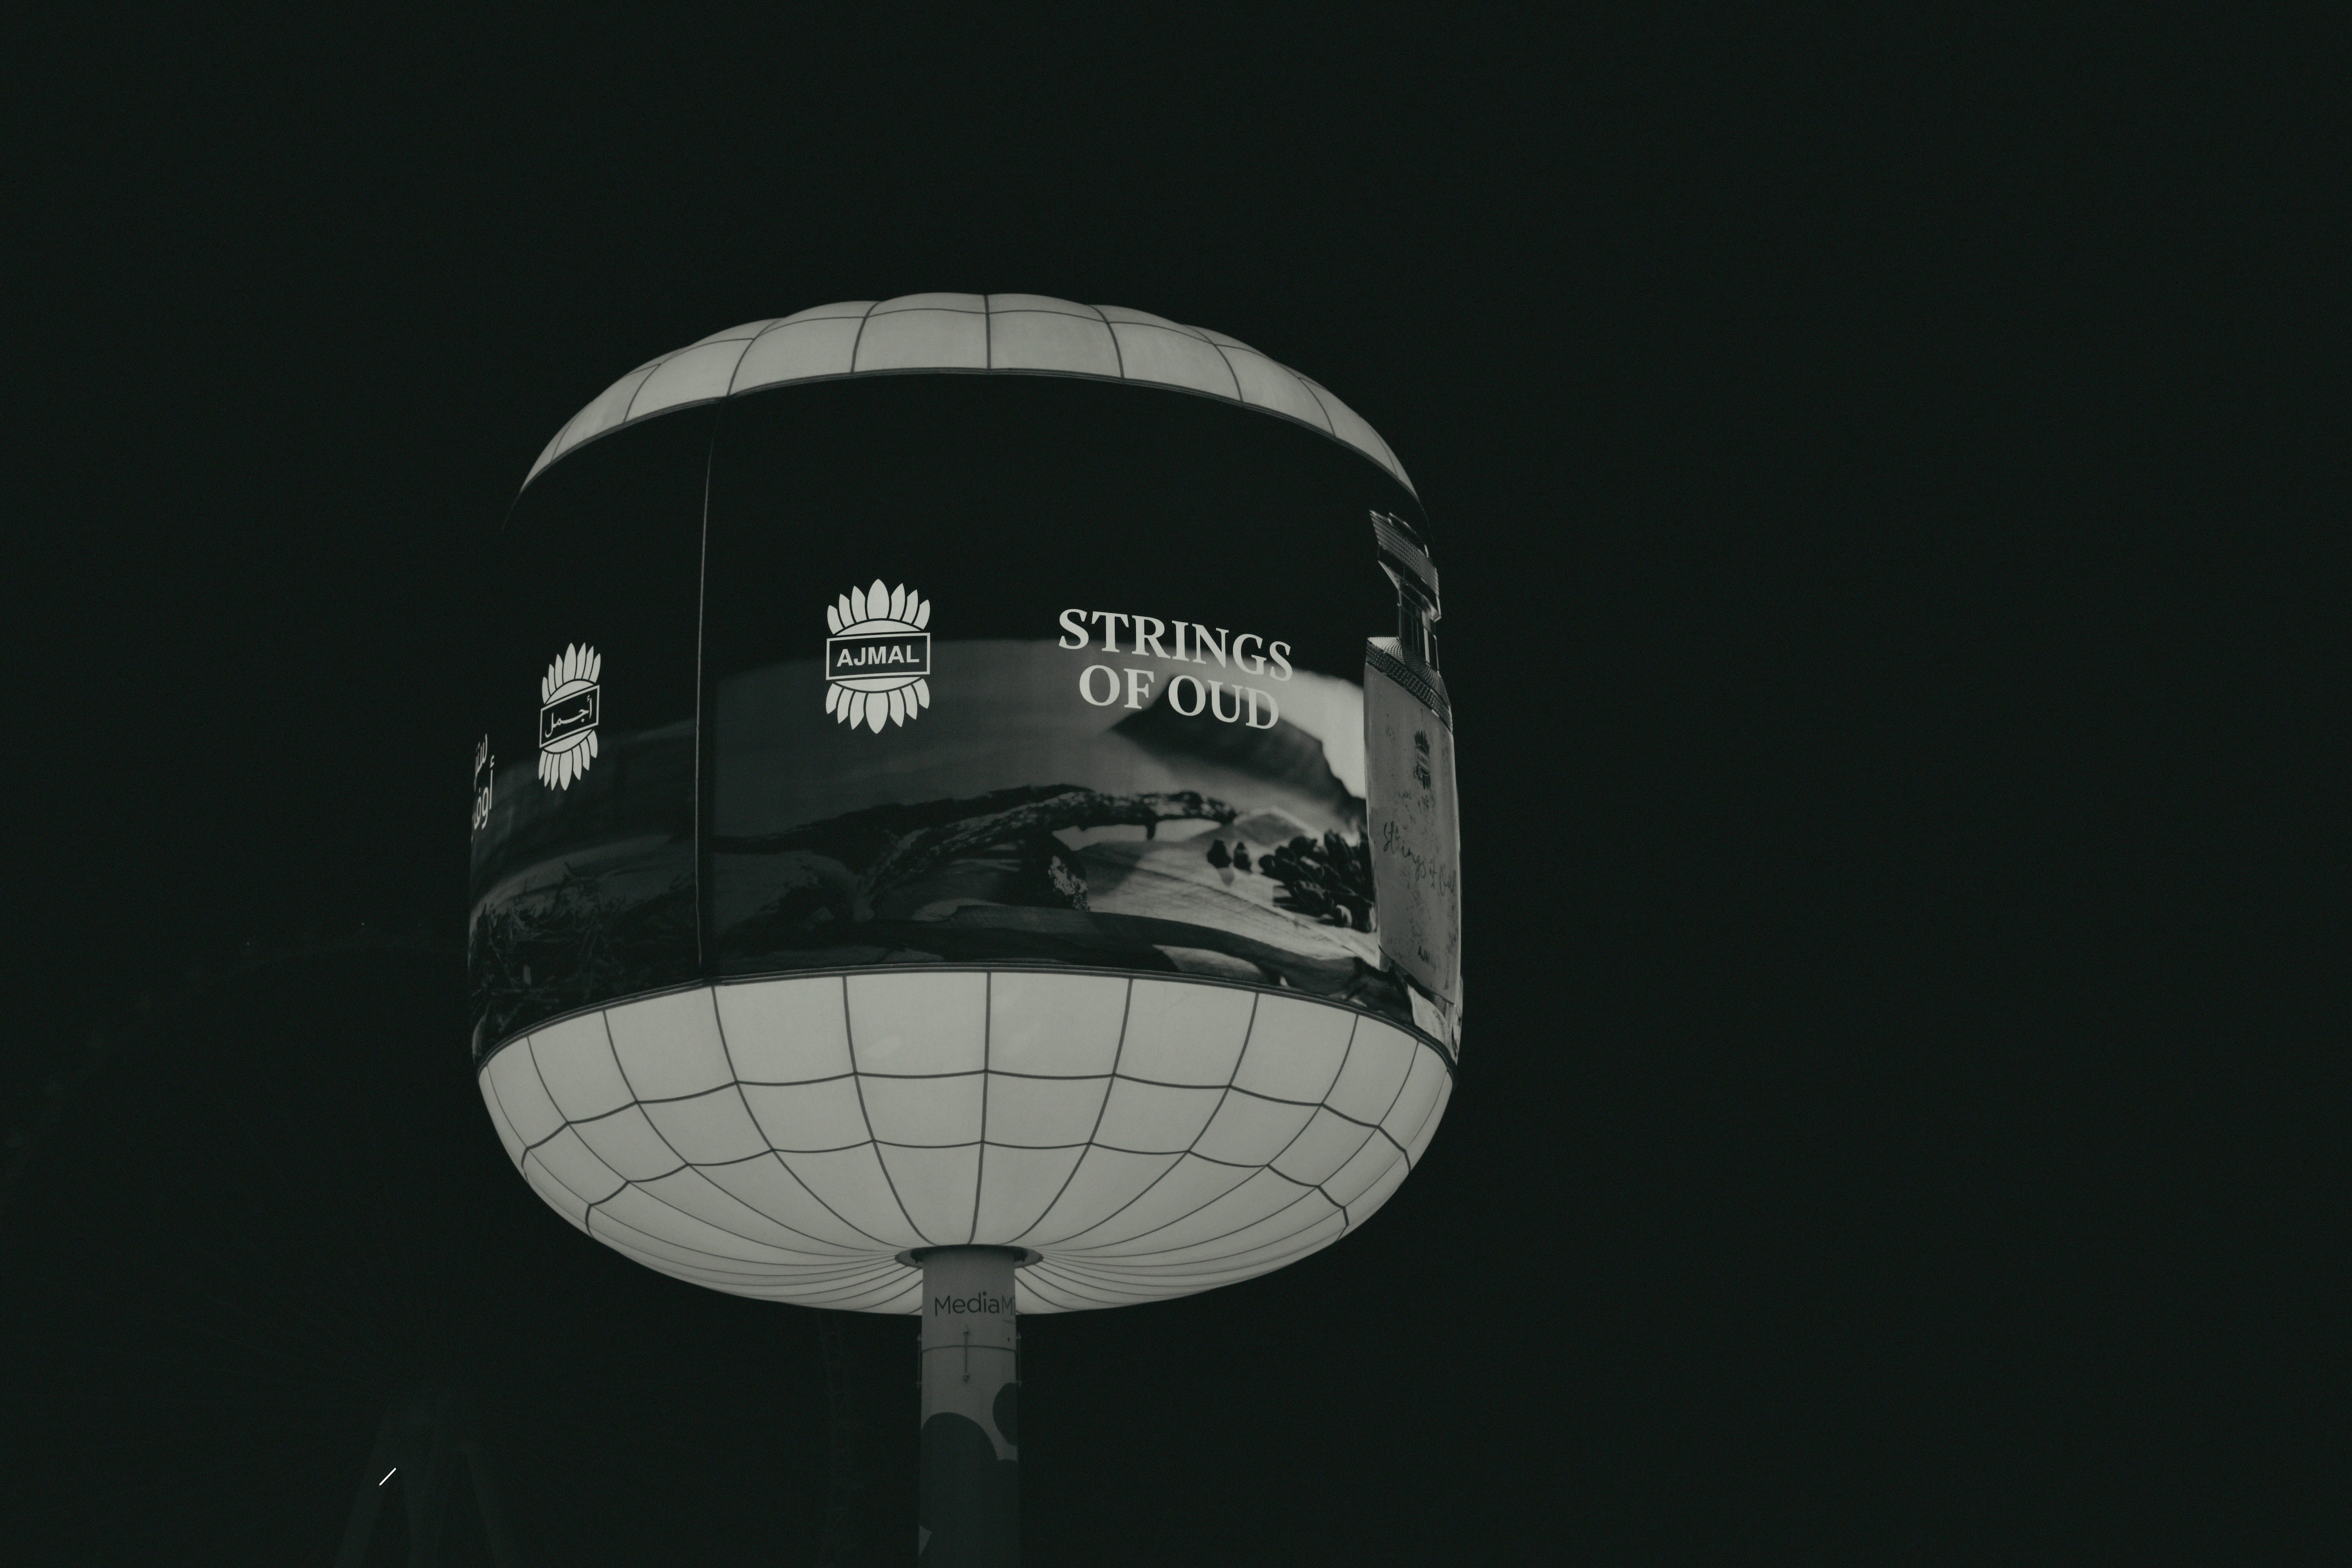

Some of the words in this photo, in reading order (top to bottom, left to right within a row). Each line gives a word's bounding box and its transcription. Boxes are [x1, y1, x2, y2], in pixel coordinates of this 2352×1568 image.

[837, 645, 920, 667] AJMAL
[1058, 608, 1293, 681] STRINGS
[545, 695, 592, 738] أجمل
[1079, 665, 1154, 709] OF
[1168, 675, 1279, 729] OUD
